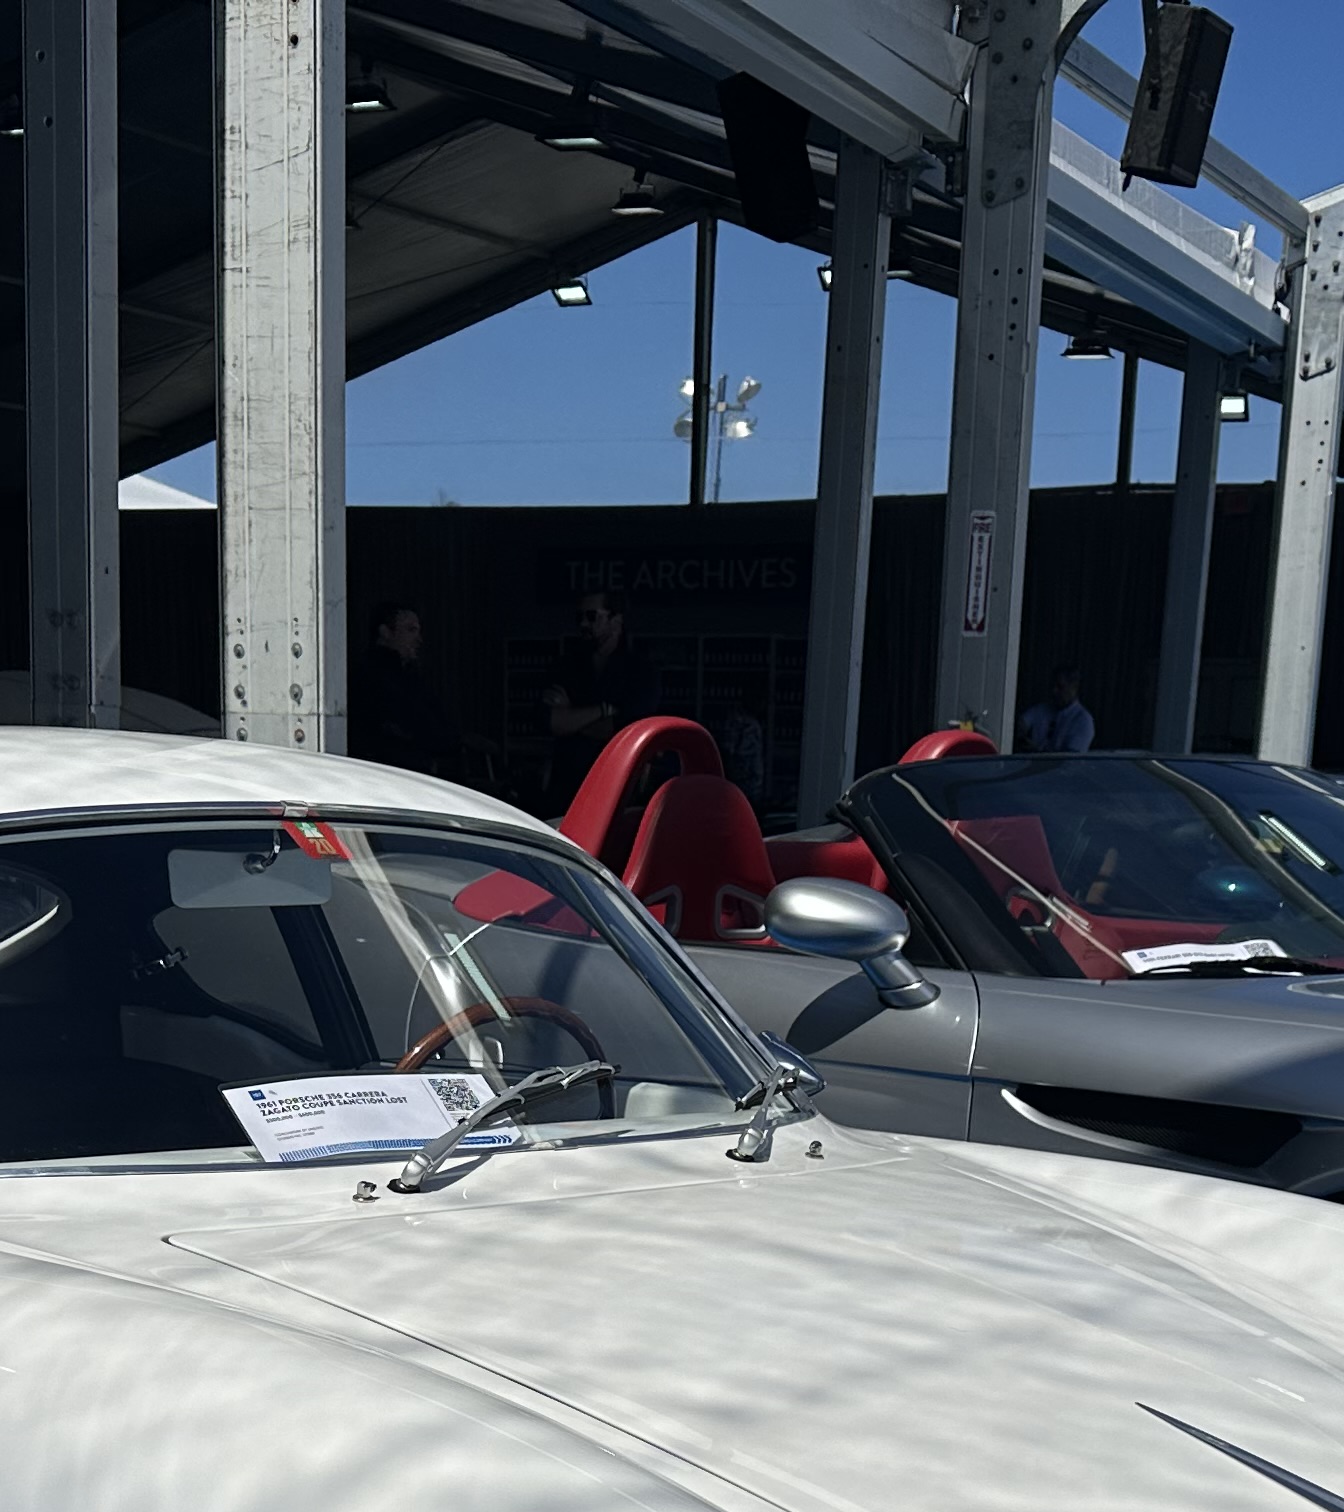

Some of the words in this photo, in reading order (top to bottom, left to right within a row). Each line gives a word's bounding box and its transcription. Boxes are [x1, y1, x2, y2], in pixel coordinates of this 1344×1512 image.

[565, 559, 626, 591] THE
[632, 556, 798, 590] ARCHIVES
[279, 1094, 325, 1106] PORSCHE
[344, 1090, 388, 1098] CARRERA
[260, 1105, 300, 1117] ZAGATO
